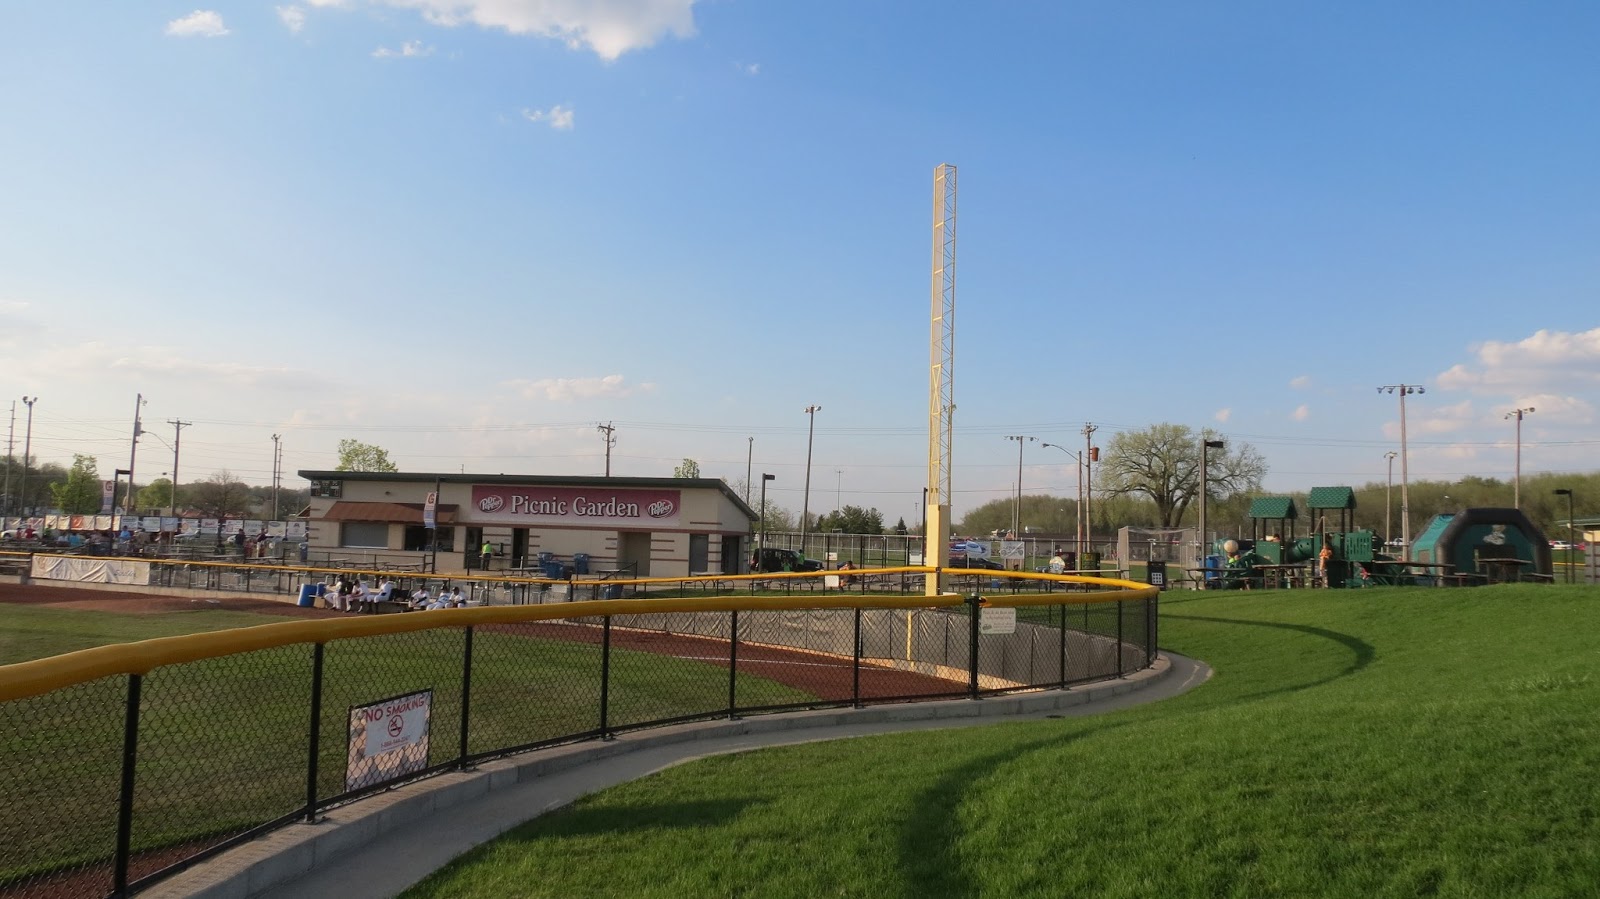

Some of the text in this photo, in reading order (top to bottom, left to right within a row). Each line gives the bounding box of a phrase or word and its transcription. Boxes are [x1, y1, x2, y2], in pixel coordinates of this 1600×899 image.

[511, 495, 640, 517] Picnic Garden
[364, 709, 383, 722] NO
